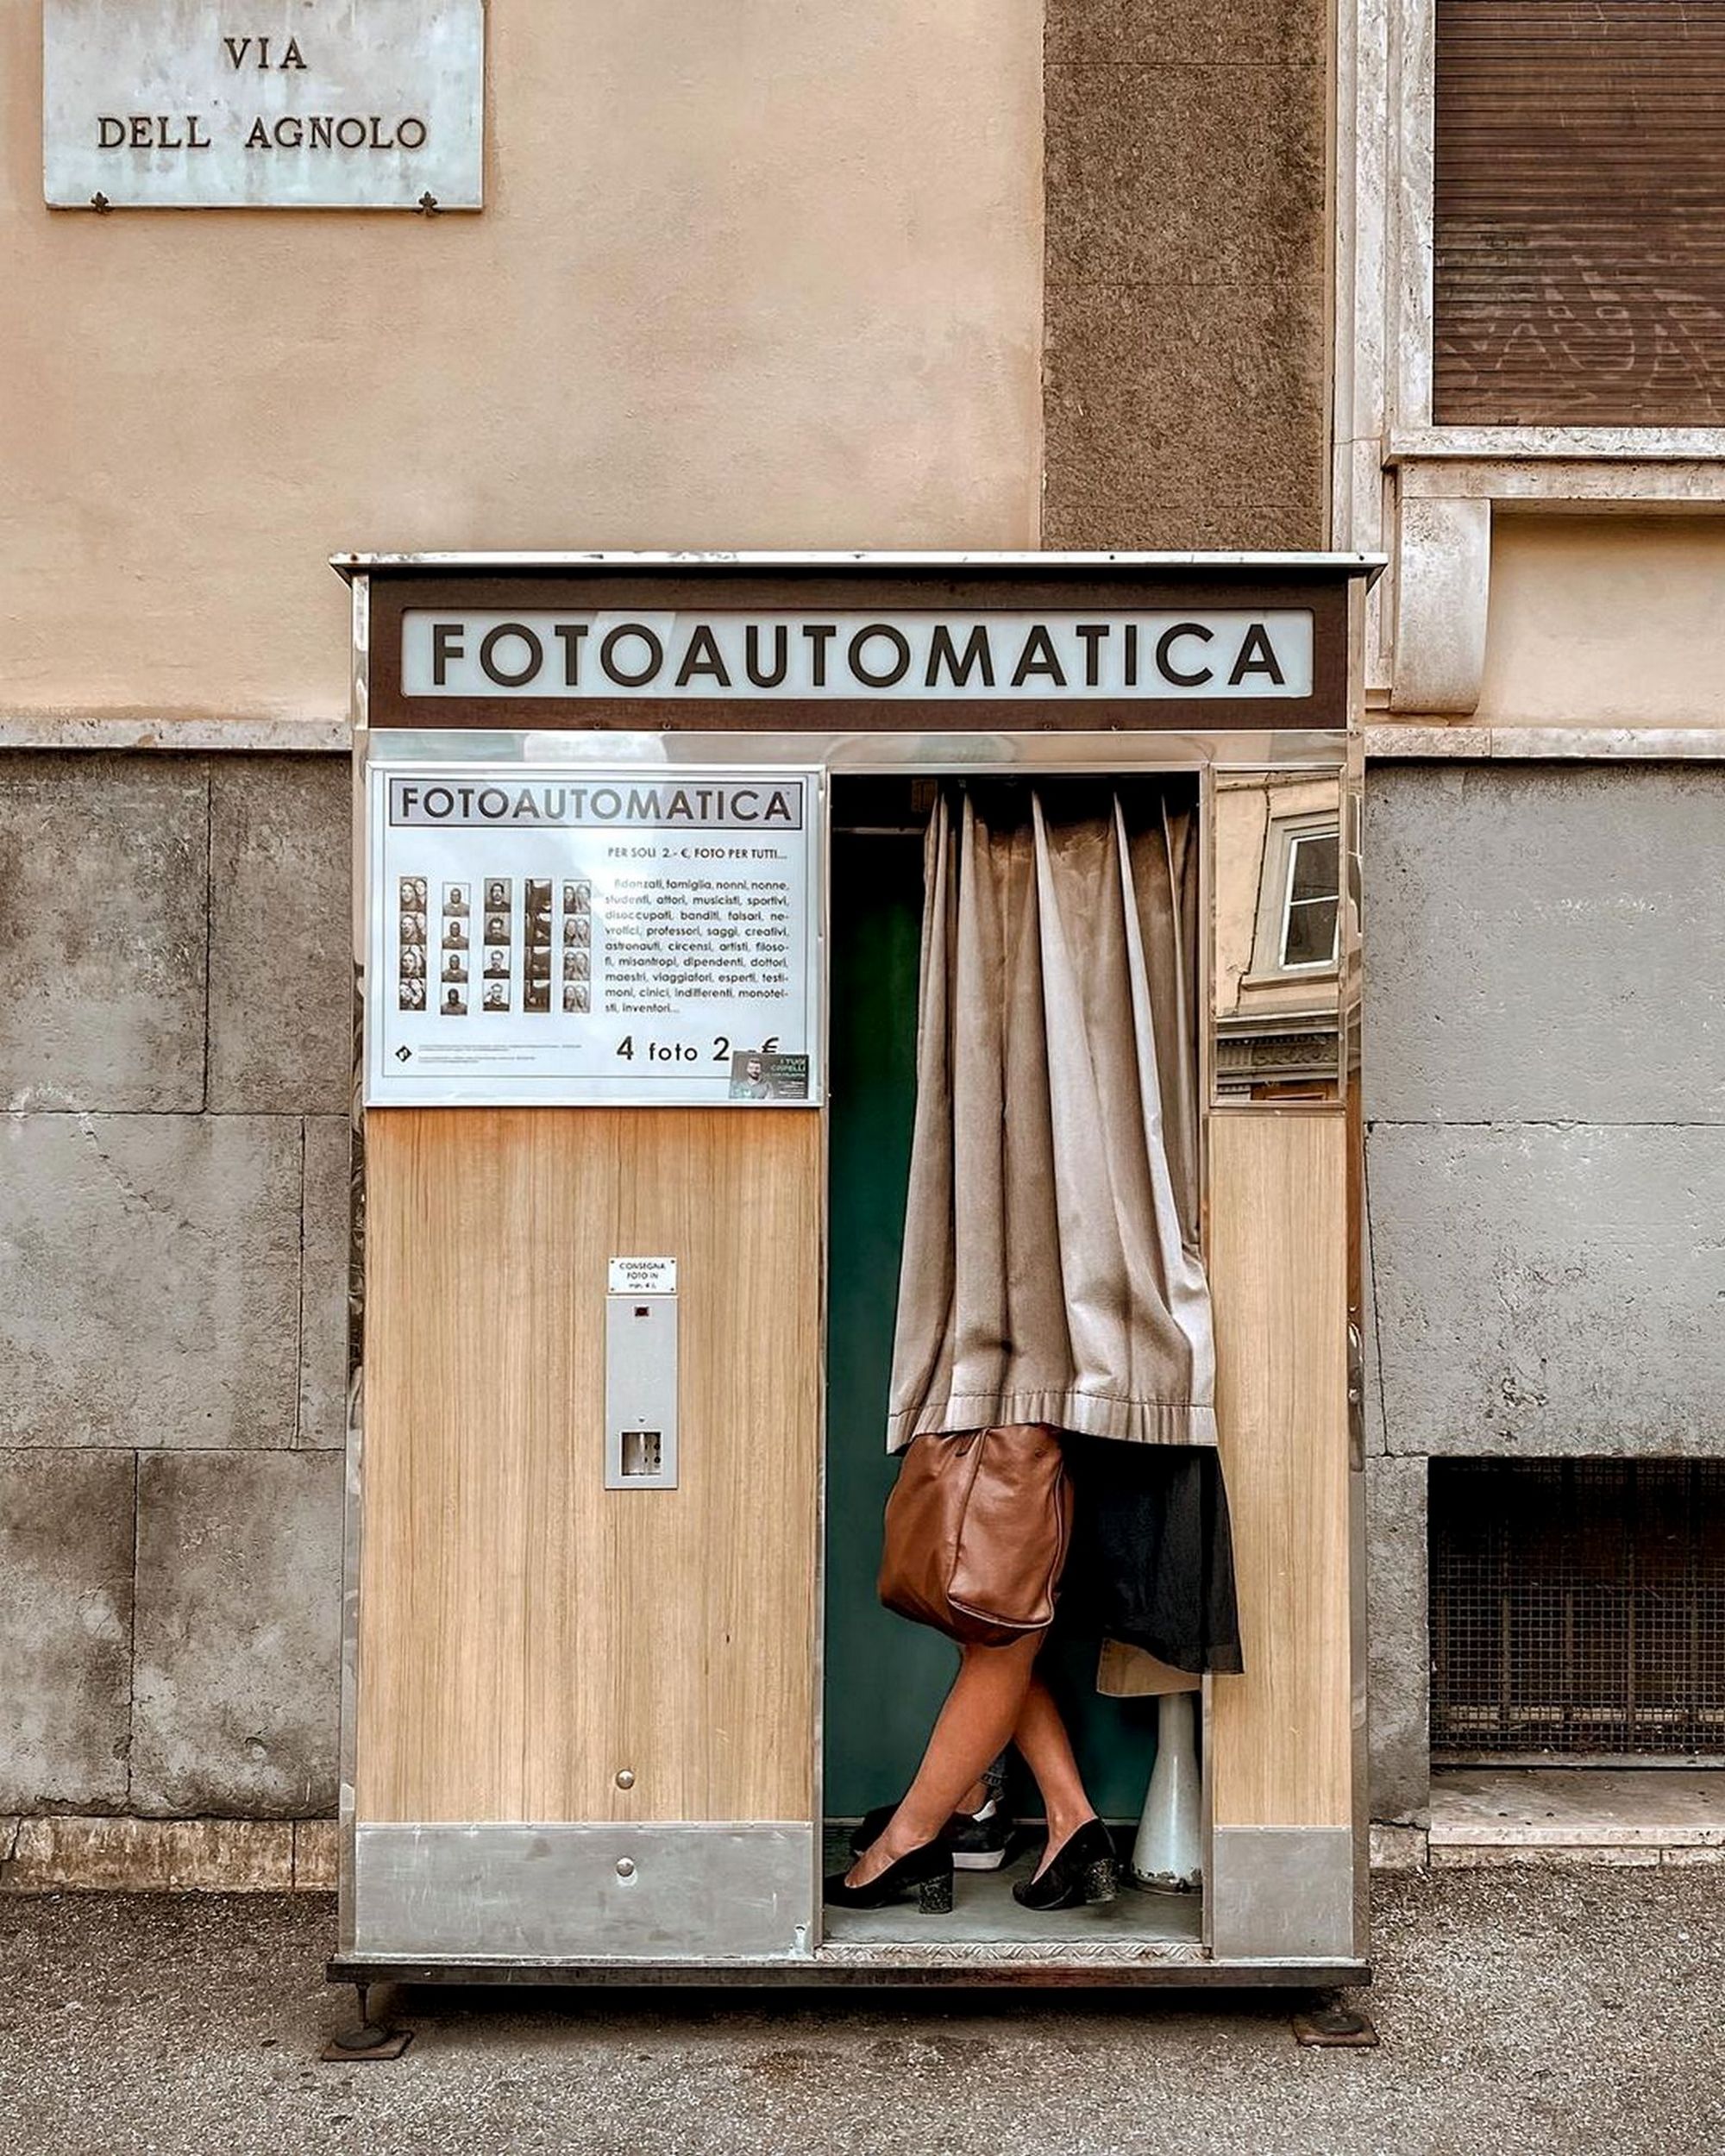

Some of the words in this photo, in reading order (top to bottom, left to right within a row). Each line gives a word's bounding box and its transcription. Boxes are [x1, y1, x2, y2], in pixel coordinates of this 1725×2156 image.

[223, 38, 307, 70] VIA
[97, 117, 211, 149] DELL
[245, 117, 427, 149] AGNOLO
[433, 623, 1285, 687] FOTOAUTOMATICA
[402, 787, 792, 821] FOTOAUTOMATICA
[608, 848, 628, 858] PER
[631, 848, 656, 858] SOLI
[694, 848, 725, 859] FOTO
[729, 849, 749, 859] PER
[666, 878, 714, 892] famiglia,
[716, 881, 750, 891] nonni,
[751, 881, 789, 891] nonne,
[605, 894, 651, 906] studenti,
[656, 894, 687, 906] attori,
[693, 895, 742, 906] musicisti,
[747, 895, 789, 907] sportivi,
[605, 911, 674, 922] disoccupati,
[681, 911, 722, 921] banditi,
[647, 925, 702, 937] professori,
[707, 926, 740, 938] saggi,
[745, 927, 789, 937] creativi,
[605, 942, 662, 952] astronauti,
[668, 942, 714, 952] circensi,
[719, 942, 750, 952] artisti,
[618, 956, 679, 968] misantropi,
[683, 956, 746, 968] dipendenti,
[750, 957, 788, 968] dottori,
[605, 972, 649, 982] maestri,
[653, 972, 714, 984] viaggiatori,
[718, 973, 758, 984] esperti,
[605, 987, 636, 998] moni,
[639, 987, 671, 998] cinici,
[674, 987, 735, 998] indifferenti,
[617, 1036, 634, 1061] 4
[649, 1043, 698, 1062] foto
